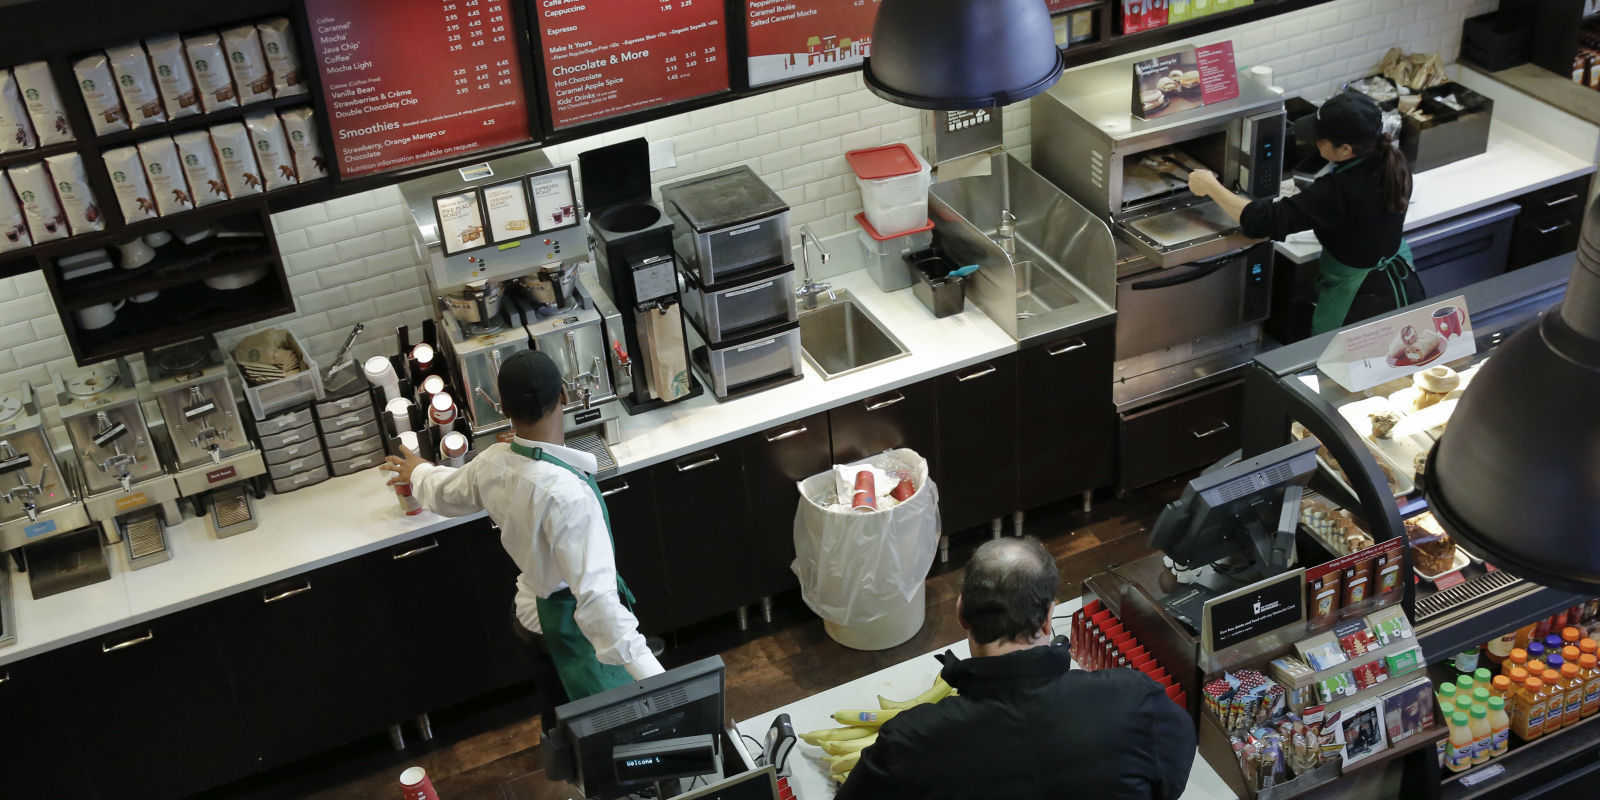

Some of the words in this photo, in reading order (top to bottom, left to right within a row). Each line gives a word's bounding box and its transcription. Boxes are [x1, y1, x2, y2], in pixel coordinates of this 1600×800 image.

[544, 5, 586, 18] Cappuccino
[750, 8, 775, 17] Caramel
[750, 18, 770, 27] Salted
[771, 13, 796, 23] Caramel
[796, 9, 817, 18] Mocha
[547, 25, 578, 36] Espresso
[322, 46, 339, 54] Java
[549, 46, 567, 54] Make
[574, 40, 592, 48] Yours
[327, 64, 352, 74] Mocha
[353, 60, 373, 70] Light
[552, 59, 607, 76] Chocolate
[610, 55, 618, 64] &
[621, 50, 649, 62] More
[554, 80, 568, 88] Hot
[568, 73, 602, 85] Chocolate
[555, 86, 584, 97] Caramel
[584, 81, 605, 91] Apple
[605, 77, 624, 86] Spice
[331, 89, 355, 99] Vanilla
[356, 86, 375, 95] Bean
[574, 93, 595, 102] Drinks
[333, 95, 379, 109] Strawberries
[335, 109, 362, 118] Double
[363, 101, 400, 114] Chocolaty
[401, 98, 418, 106] Chip
[339, 121, 400, 139] Smoothies
[384, 137, 411, 147] Orange
[412, 132, 437, 141] Mango
[344, 151, 381, 163] Chocolate
[346, 163, 376, 173] Nutrition
[377, 154, 414, 167] information
[415, 149, 442, 159] available
[626, 759, 652, 767] Welcome
